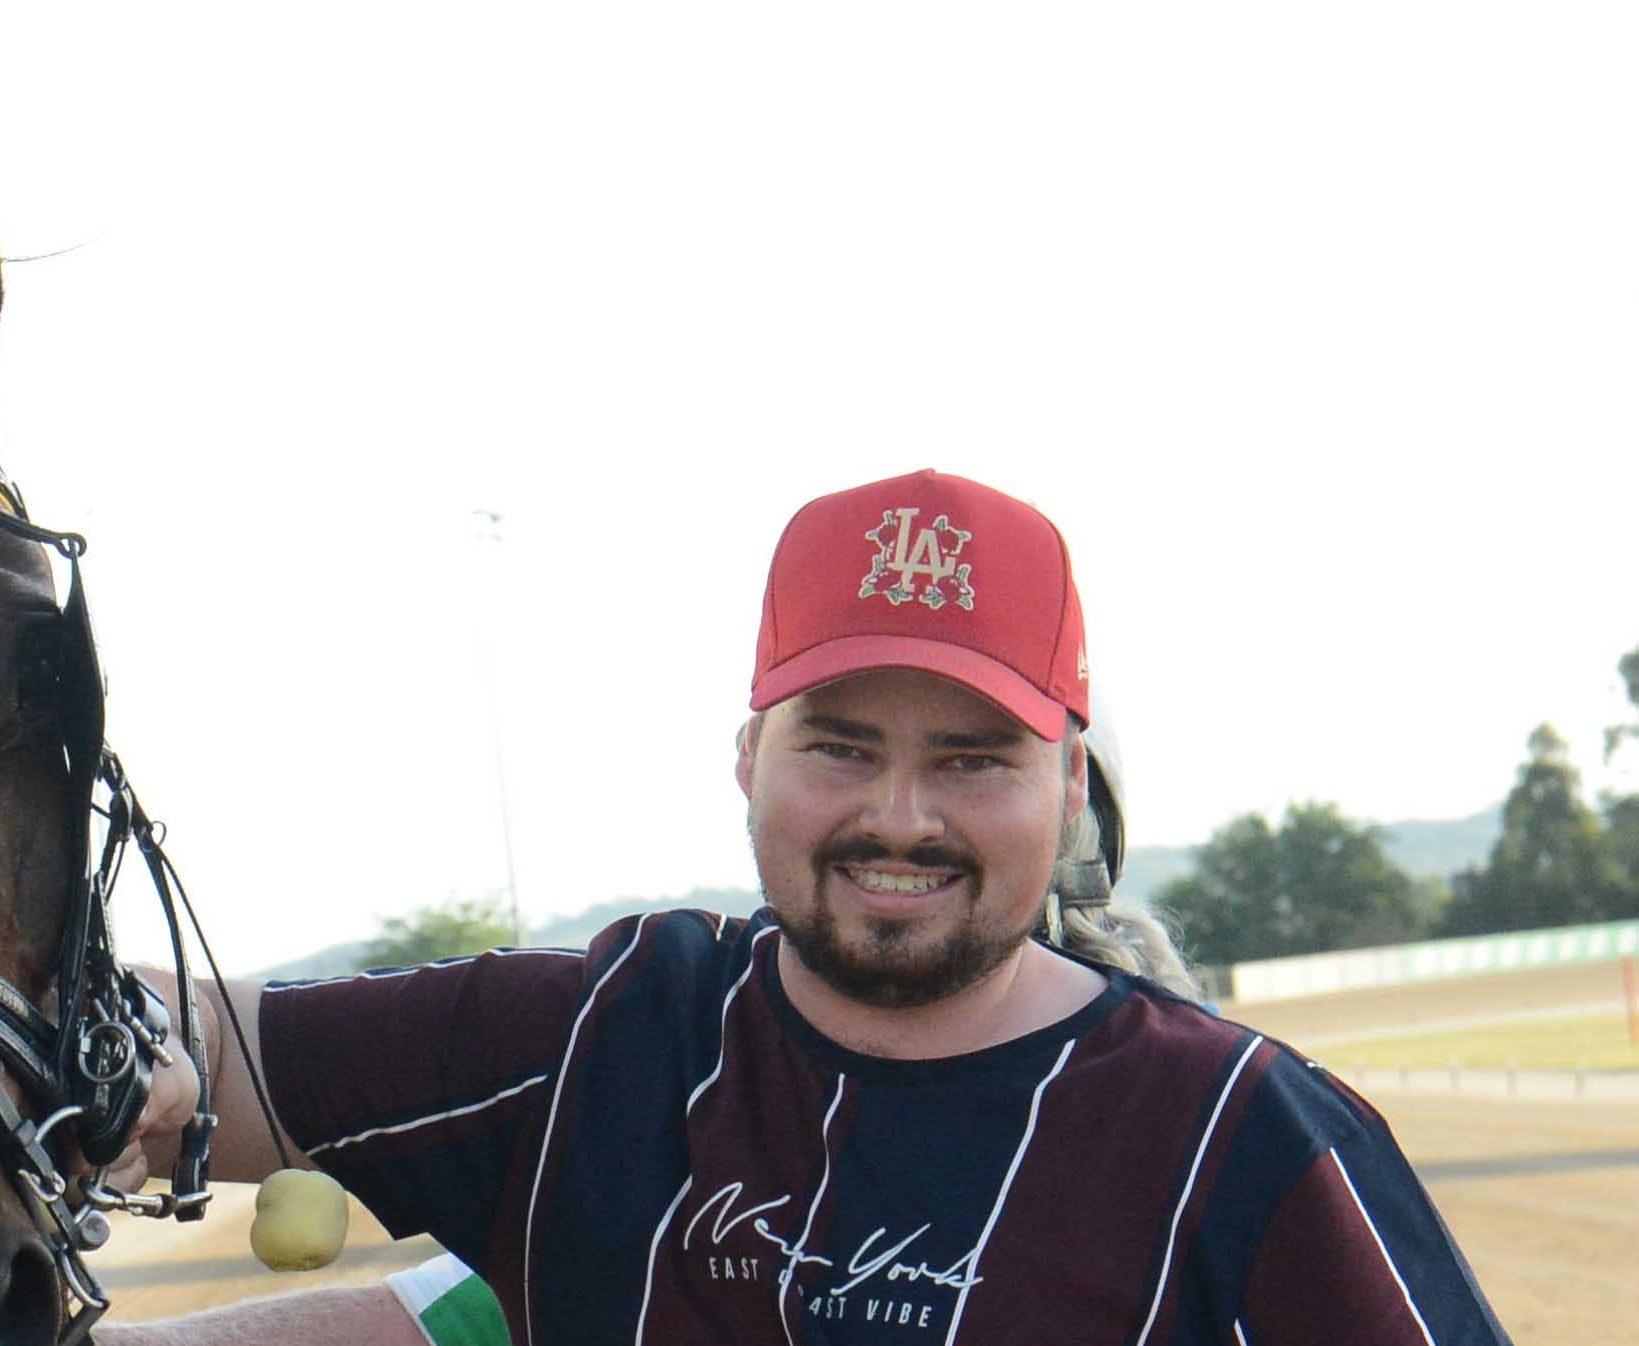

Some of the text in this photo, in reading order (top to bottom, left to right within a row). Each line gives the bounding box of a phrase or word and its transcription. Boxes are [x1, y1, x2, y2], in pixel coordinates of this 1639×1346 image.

[887, 507, 956, 592] LA
[709, 1256, 759, 1280] EAST
[866, 1298, 932, 1328] VIBE
